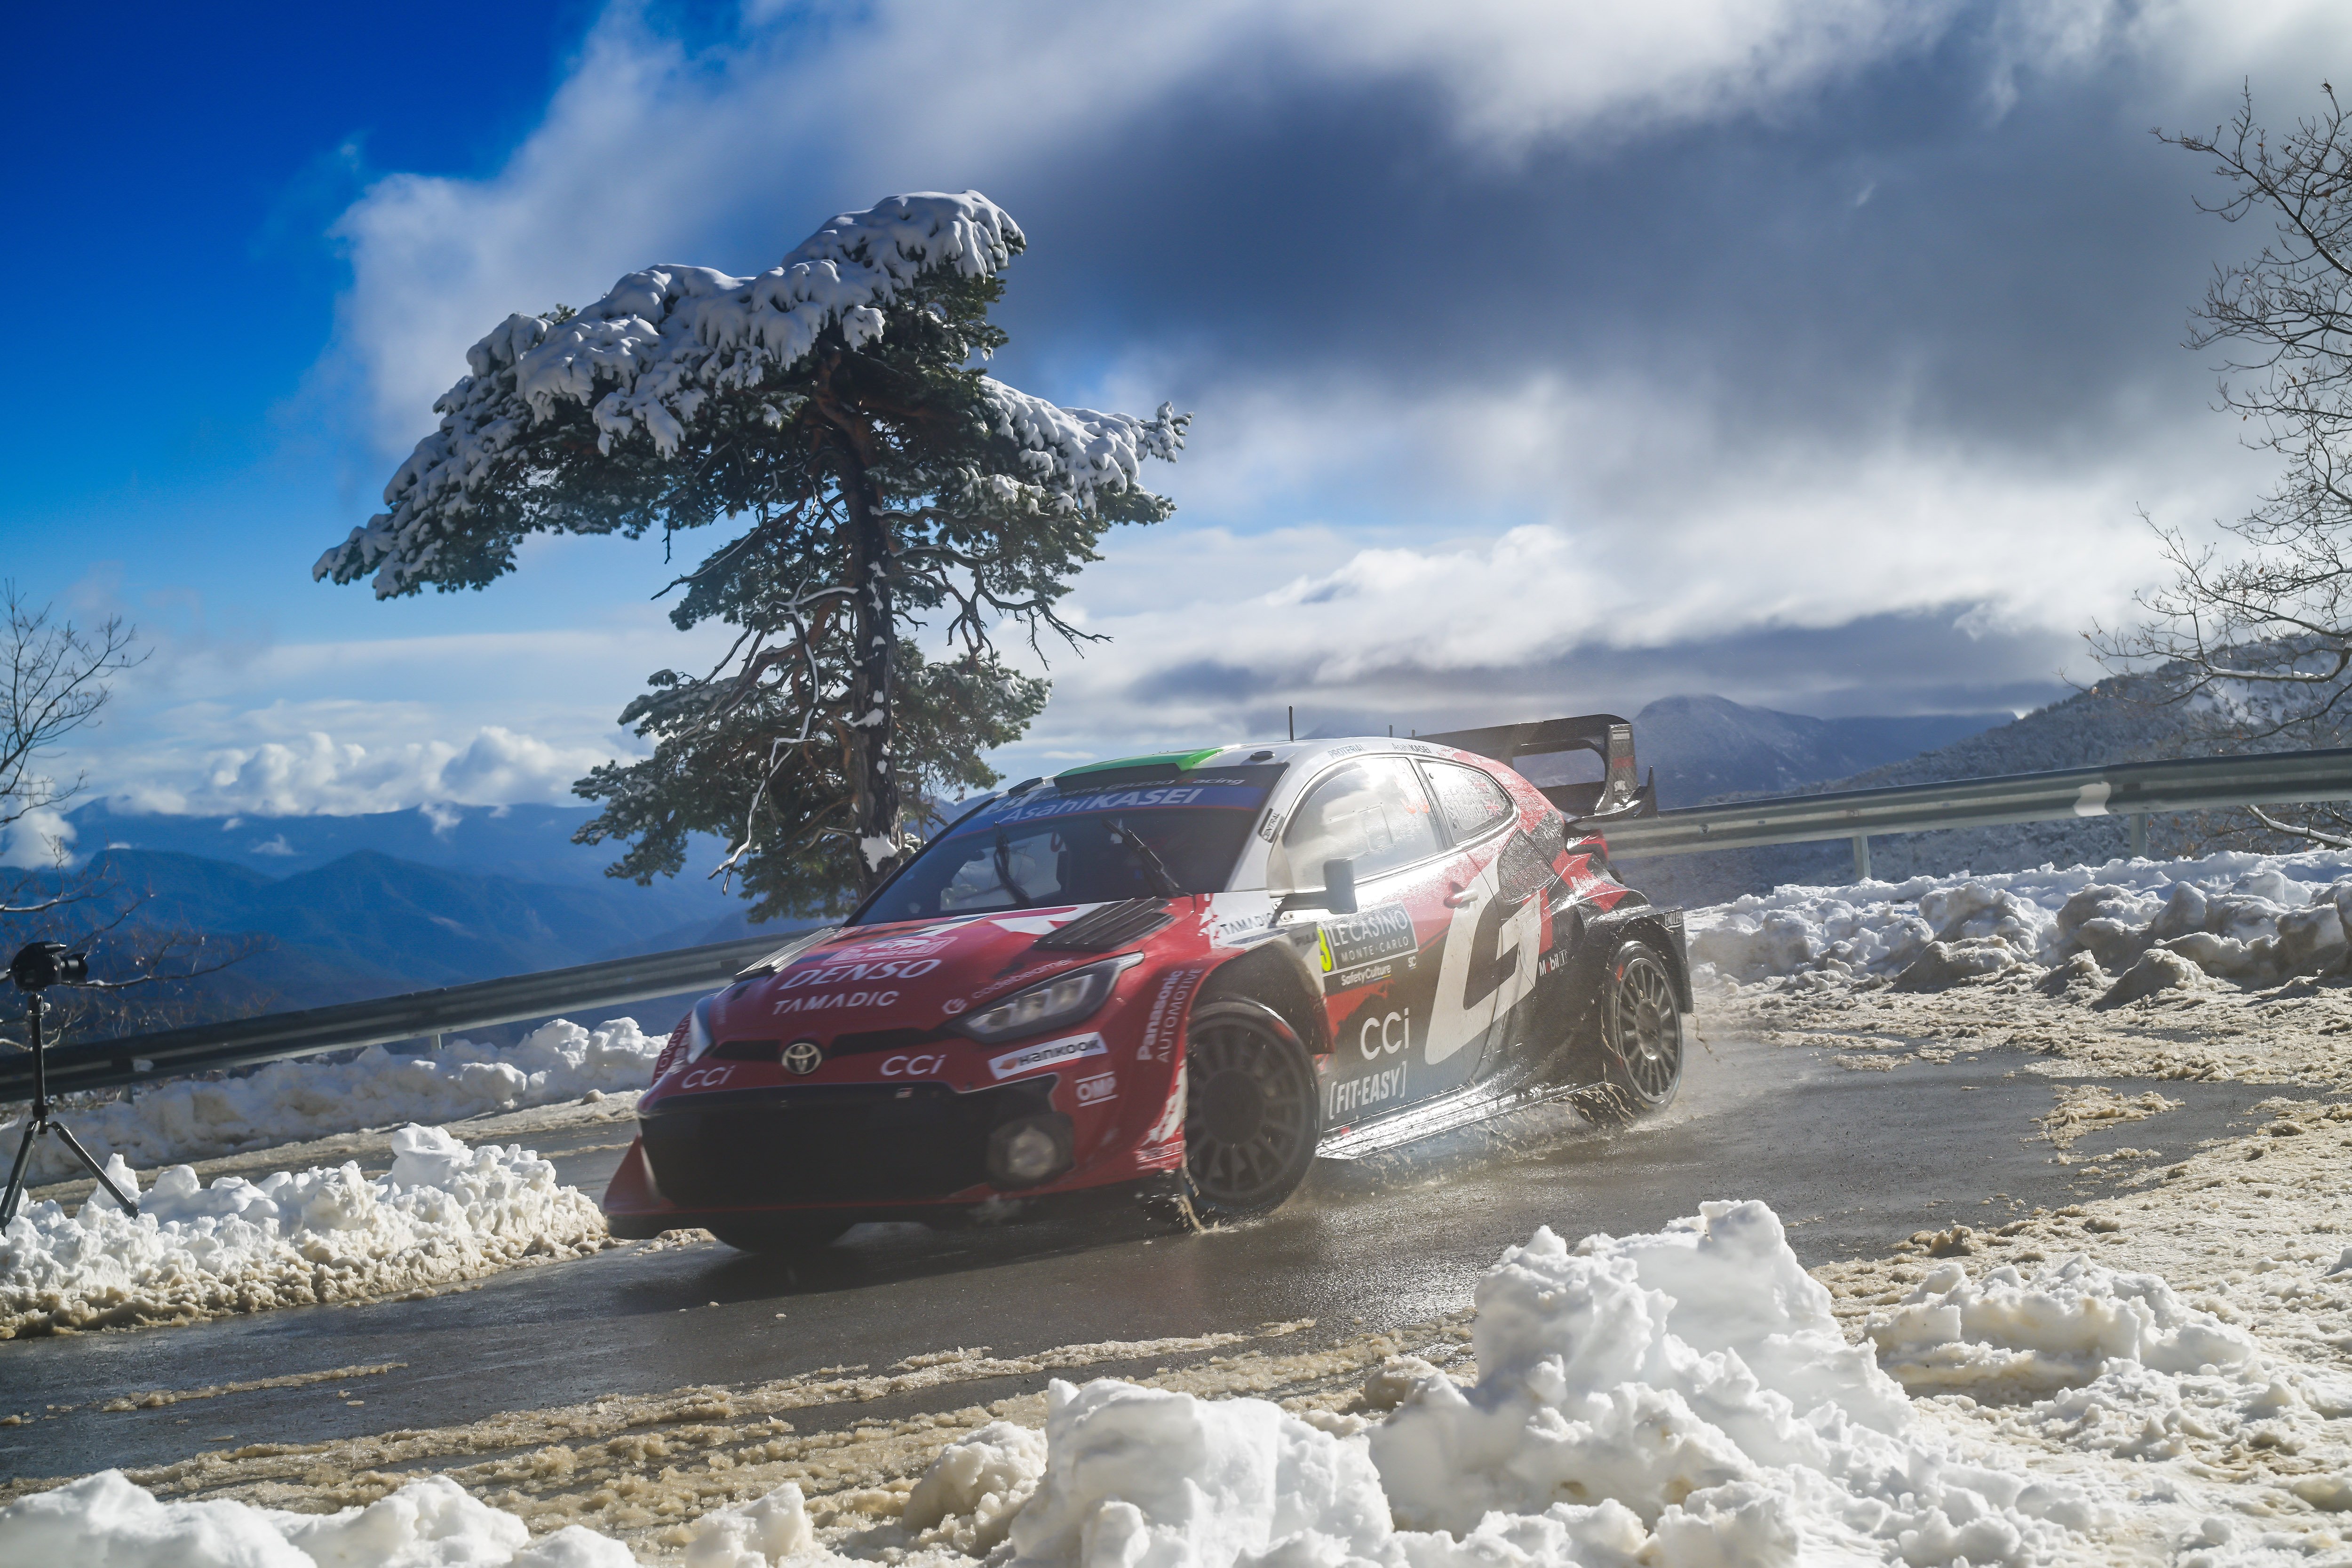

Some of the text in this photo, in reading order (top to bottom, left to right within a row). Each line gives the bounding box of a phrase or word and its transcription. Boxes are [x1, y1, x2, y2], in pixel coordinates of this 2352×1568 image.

[1033, 786, 1102, 802] TOYOTA
[1105, 780, 1176, 789] GAZOO
[998, 788, 1205, 824] AsahiKASEI
[1349, 909, 1408, 942] CASINO
[778, 959, 942, 990] DENSO
[1341, 964, 1391, 986] SafetyCulture
[1539, 953, 1559, 977] Mobil
[773, 991, 899, 1015] TAMADIC
[1136, 970, 1184, 1061] Panasonic
[1156, 968, 1205, 1064] AUTOMOTIVE
[1076, 1076, 1116, 1100] OMP
